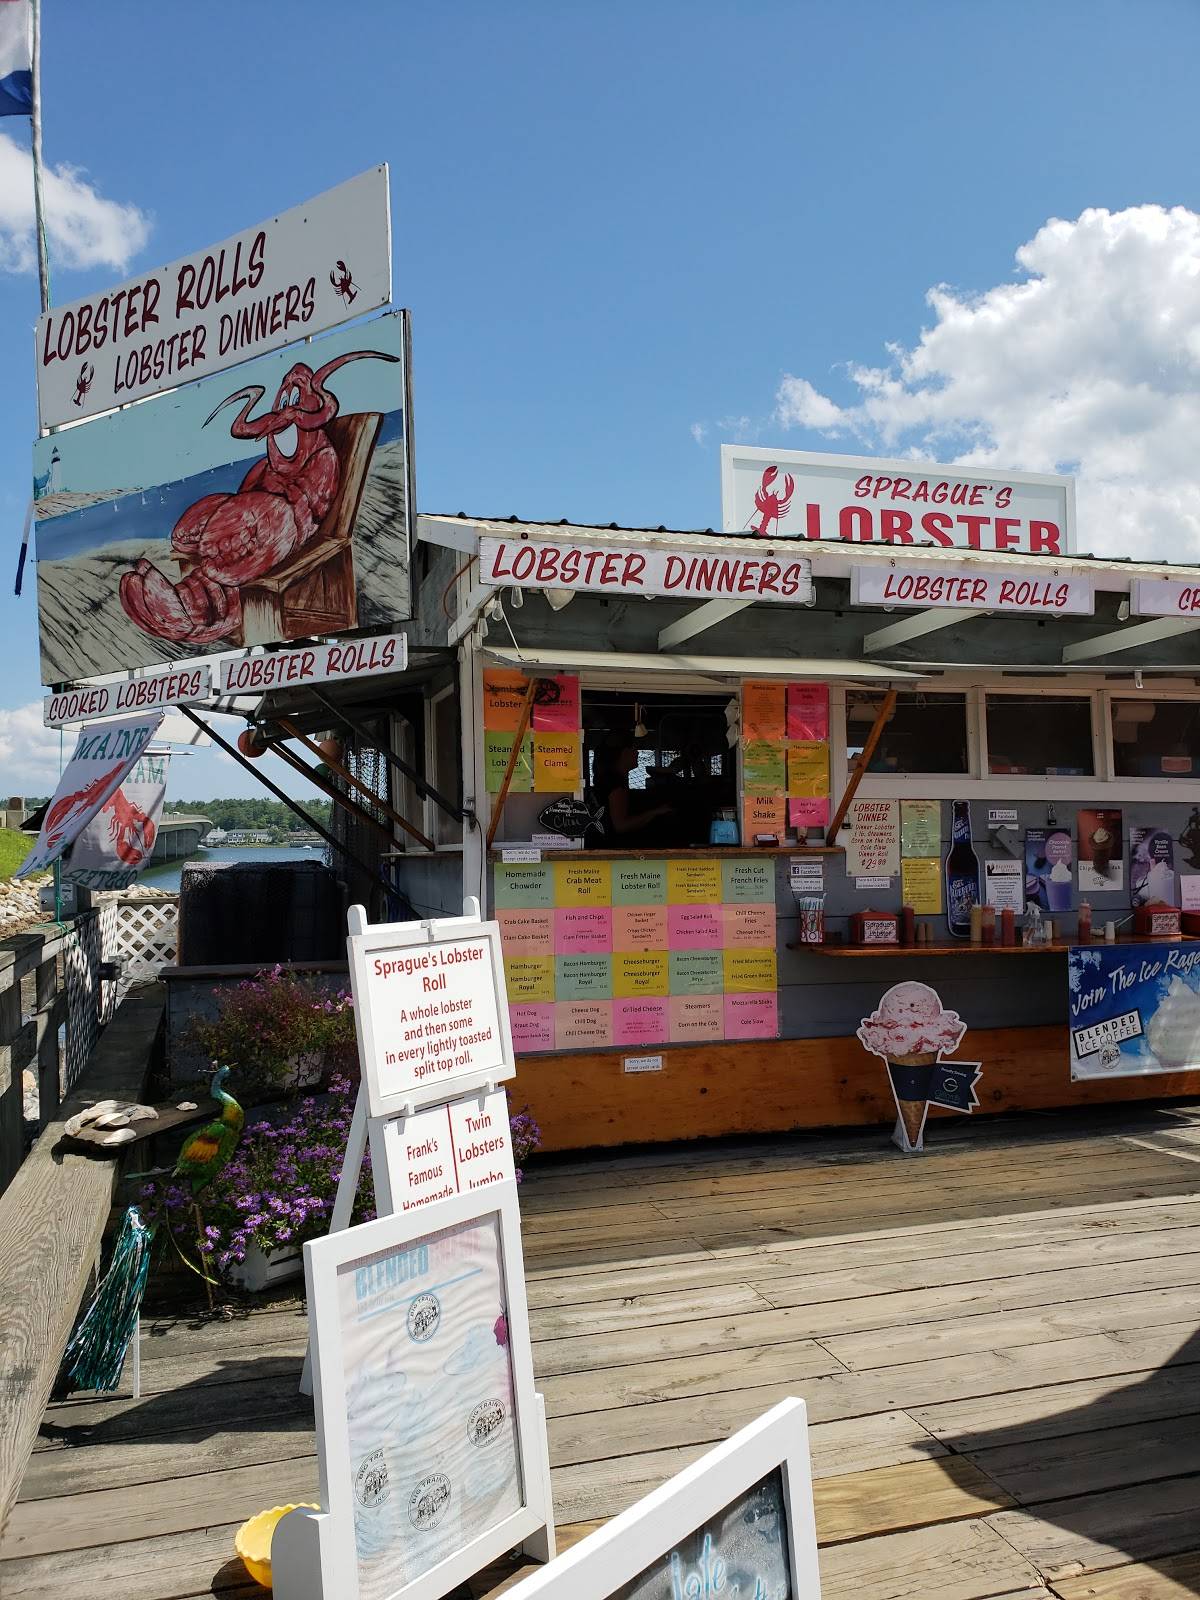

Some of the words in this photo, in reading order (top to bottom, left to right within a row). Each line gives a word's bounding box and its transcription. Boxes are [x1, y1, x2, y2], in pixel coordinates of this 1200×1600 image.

[43, 278, 161, 366] LOBSTER
[175, 232, 266, 319] ROLLS
[114, 325, 206, 394] LOBSTER
[218, 277, 316, 356] DINNERS
[854, 475, 1013, 509] SPRAGUE'S
[491, 544, 647, 586] LOBSTER
[663, 555, 802, 596] DINNERS
[884, 574, 987, 602] LOBSTER
[999, 579, 1070, 607] ROLLS
[226, 652, 314, 691] LOBSTER
[326, 638, 397, 674] ROLLS
[49, 688, 110, 721] COOKED
[116, 670, 202, 717] LOBSTERS
[490, 700, 522, 709] Lobster
[72, 727, 149, 762] MAINE
[538, 745, 573, 754] Steamed
[492, 759, 523, 767] Lober
[544, 759, 568, 767] Clams
[756, 796, 773, 805] Milk
[853, 803, 891, 812] LOBSTER
[752, 810, 776, 819] Shake
[857, 812, 888, 822] DINNER
[505, 870, 546, 878] Homemade
[510, 882, 542, 890] Chowder
[374, 952, 438, 979] Sprague's
[440, 947, 484, 966] Lobster
[510, 963, 543, 971] Hamburger
[422, 973, 447, 992] Roll
[510, 975, 543, 983] Hamburger
[1071, 986, 1107, 1017] Join
[1108, 964, 1137, 995] The
[1138, 960, 1162, 983] Ice
[400, 1009, 408, 1023] A
[409, 1003, 439, 1021] whole
[440, 998, 473, 1014] lobster
[404, 1024, 423, 1041] and
[424, 1021, 447, 1037] then
[449, 1016, 473, 1031] some
[1078, 1014, 1136, 1042] BLENDED
[1080, 1041, 1097, 1053] ICE
[1099, 1025, 1138, 1045] COFFEE
[385, 1051, 396, 1065] in
[398, 1046, 425, 1060] every
[426, 1036, 457, 1057] lightly
[459, 1026, 492, 1047] toasted
[414, 1060, 436, 1080] split
[437, 1057, 453, 1072] top
[455, 1050, 473, 1066] roll.
[465, 1113, 491, 1134] Twin
[406, 1137, 439, 1161] Frank's
[458, 1136, 505, 1163] Lobsters
[408, 1164, 443, 1187] Famous
[469, 1408, 480, 1424] BIG
[479, 1400, 501, 1410] TRAIN
[421, 1475, 447, 1489] TRAIN
